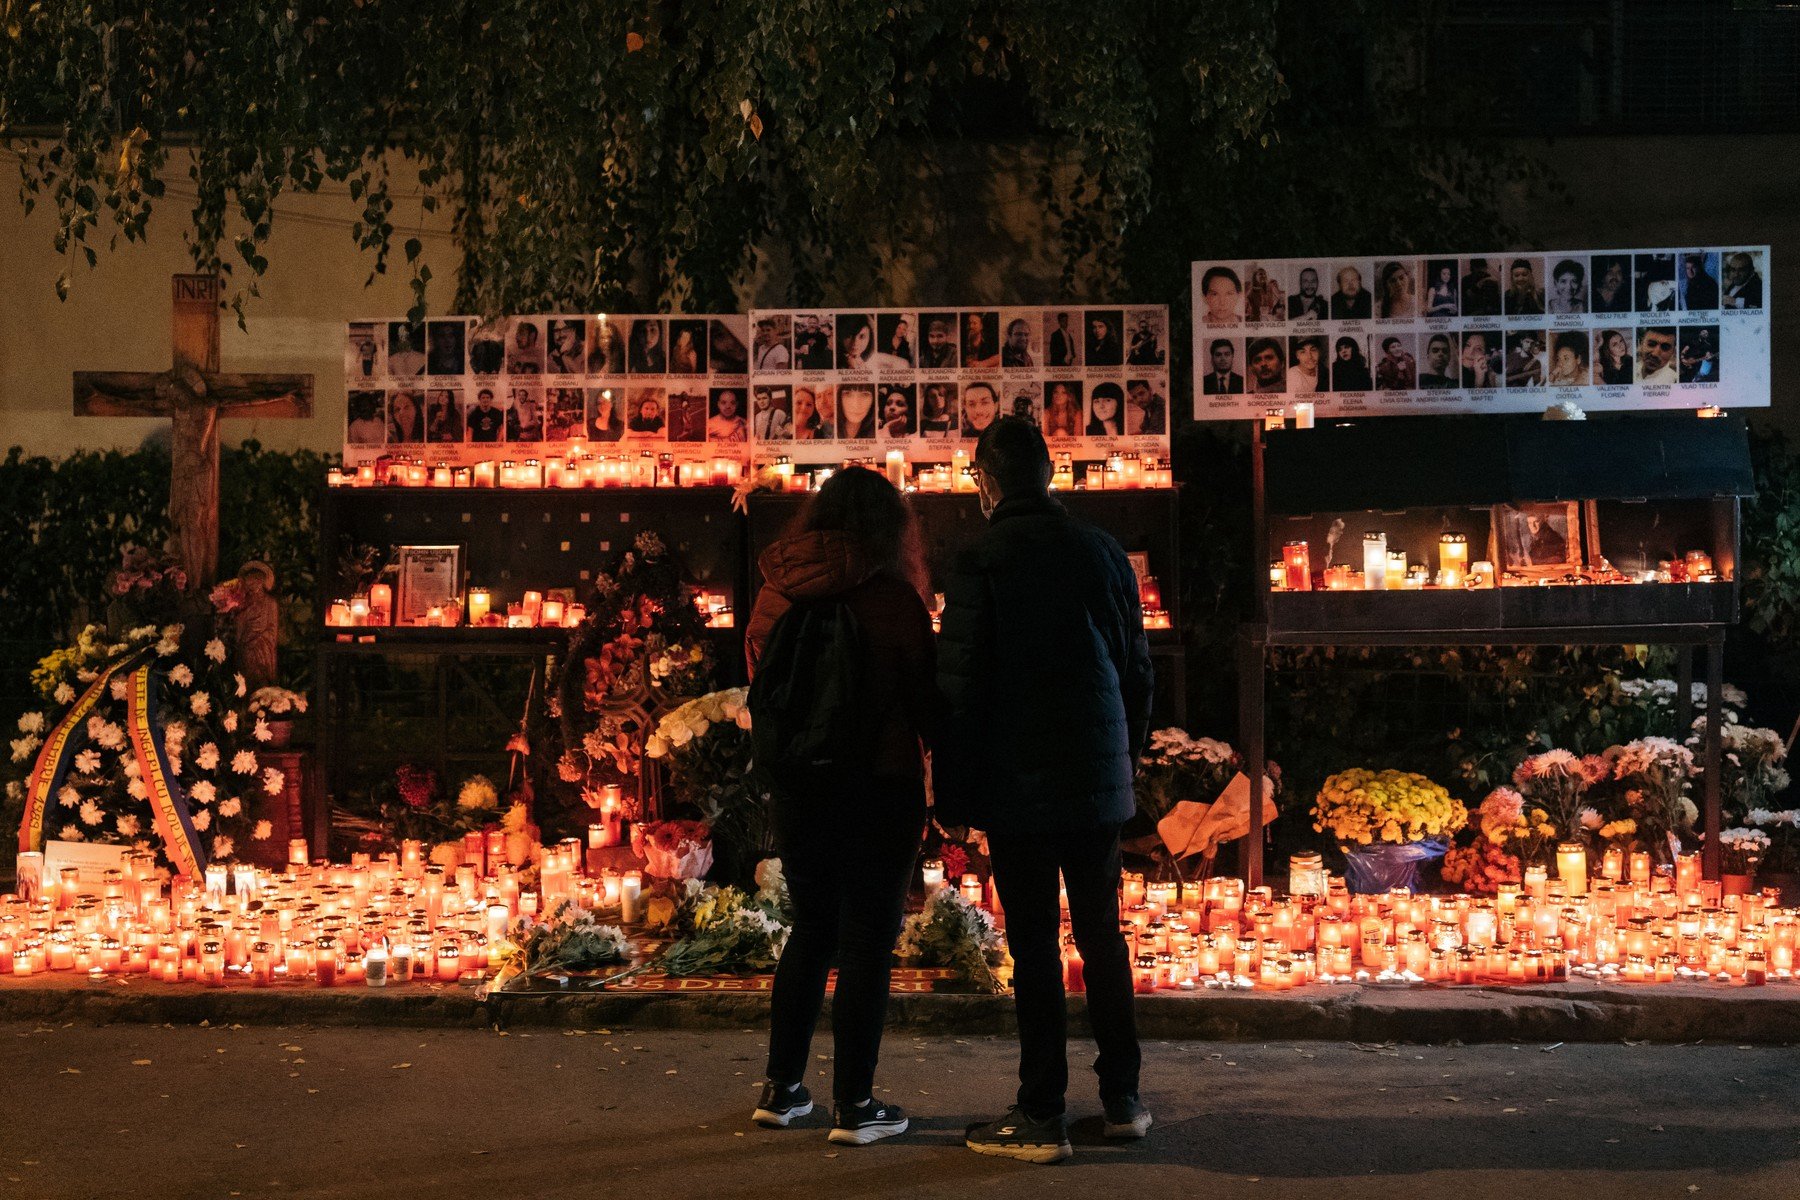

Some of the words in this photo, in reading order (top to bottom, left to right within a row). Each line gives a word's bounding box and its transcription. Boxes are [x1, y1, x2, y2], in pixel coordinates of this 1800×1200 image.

[176, 279, 213, 299] INRI
[135, 708, 146, 726] DE
[153, 779, 168, 799] CU
[175, 834, 188, 852] DE
[30, 795, 45, 829] 1989
[679, 978, 743, 990] DE
